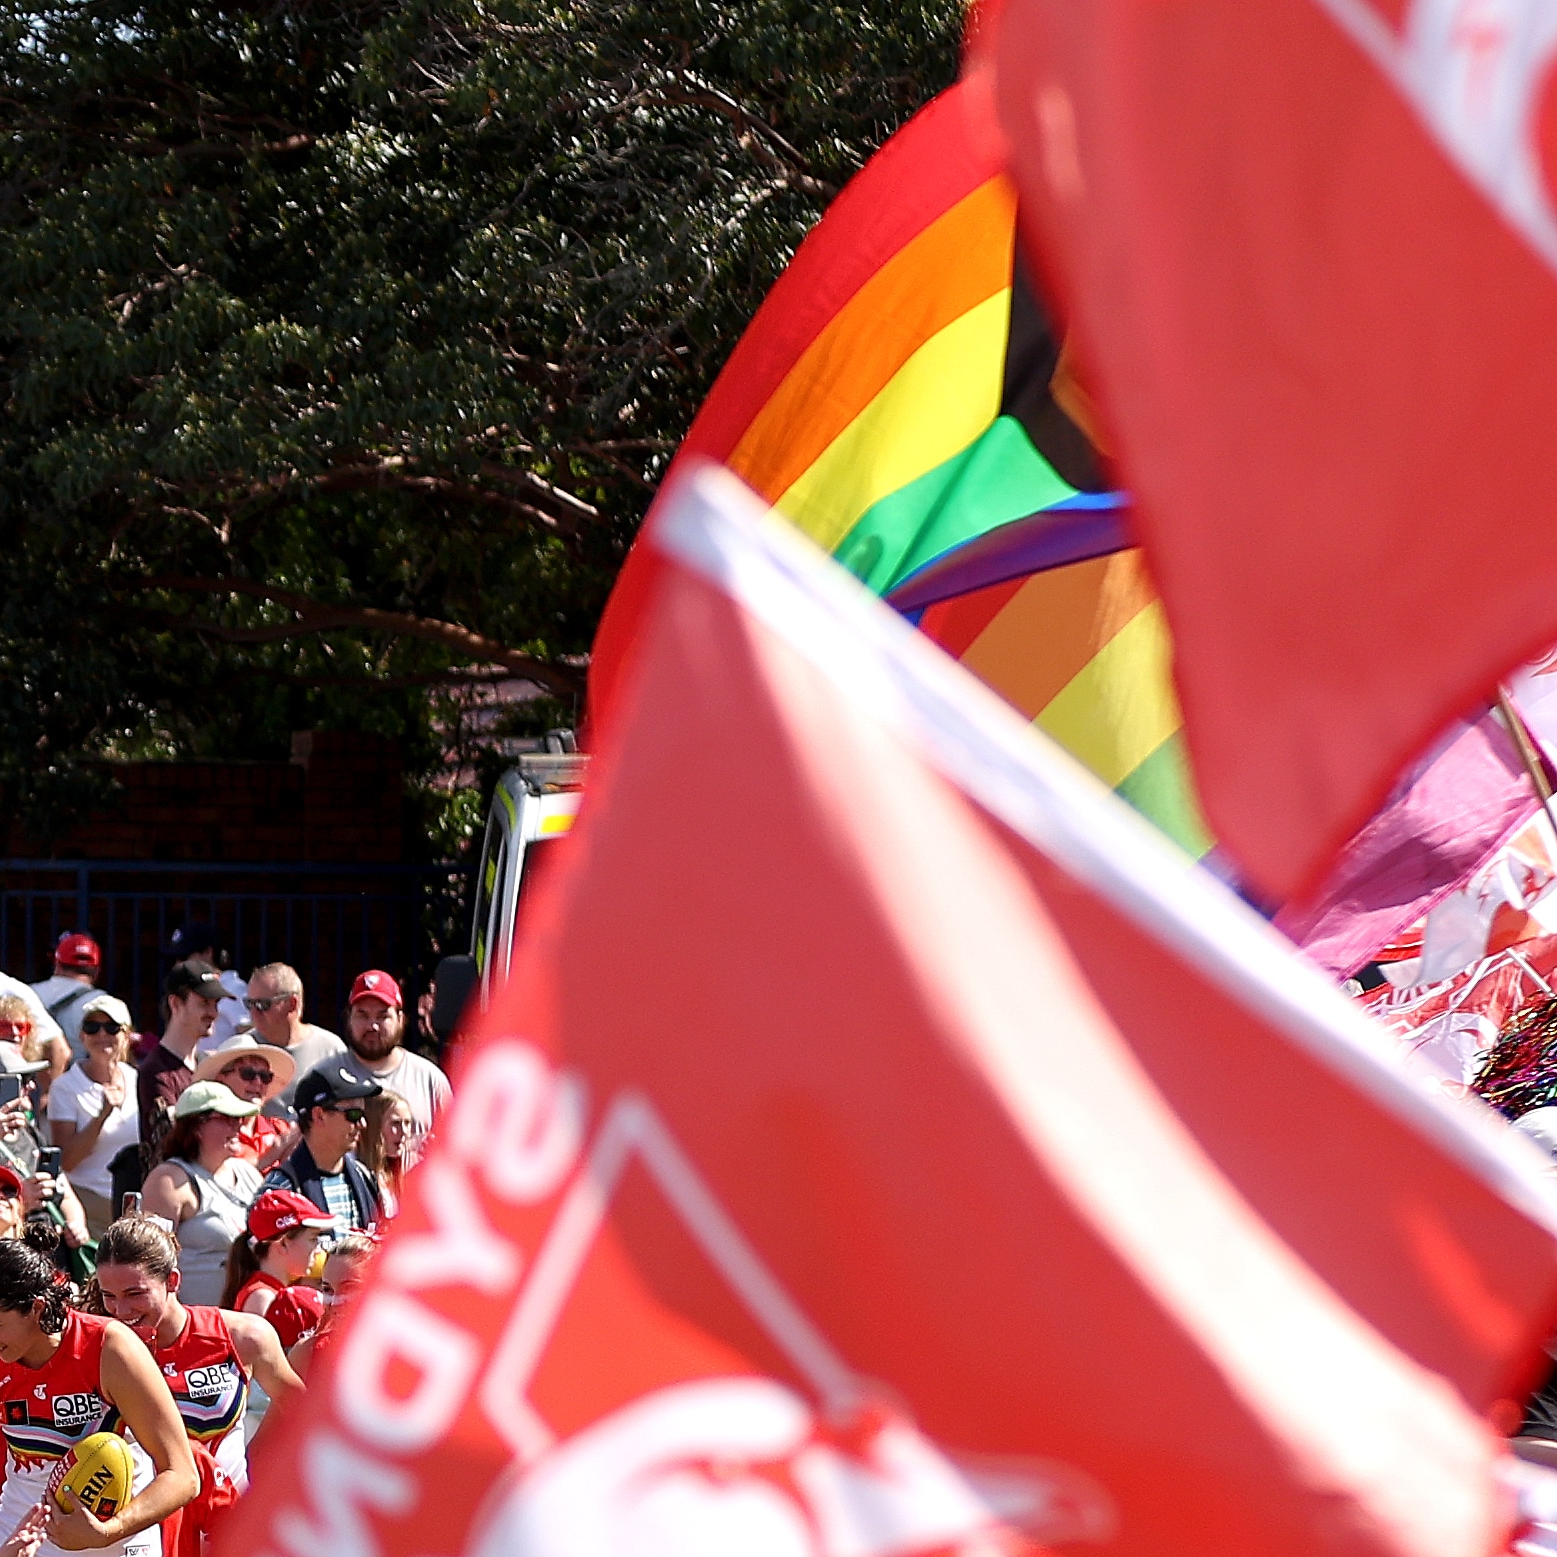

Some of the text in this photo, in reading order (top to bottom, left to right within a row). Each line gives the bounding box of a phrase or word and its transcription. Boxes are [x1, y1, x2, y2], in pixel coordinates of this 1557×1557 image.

[188, 1364, 232, 1388] QBE
[53, 1393, 102, 1417] QBE
[55, 1411, 103, 1427] INSURANCE
